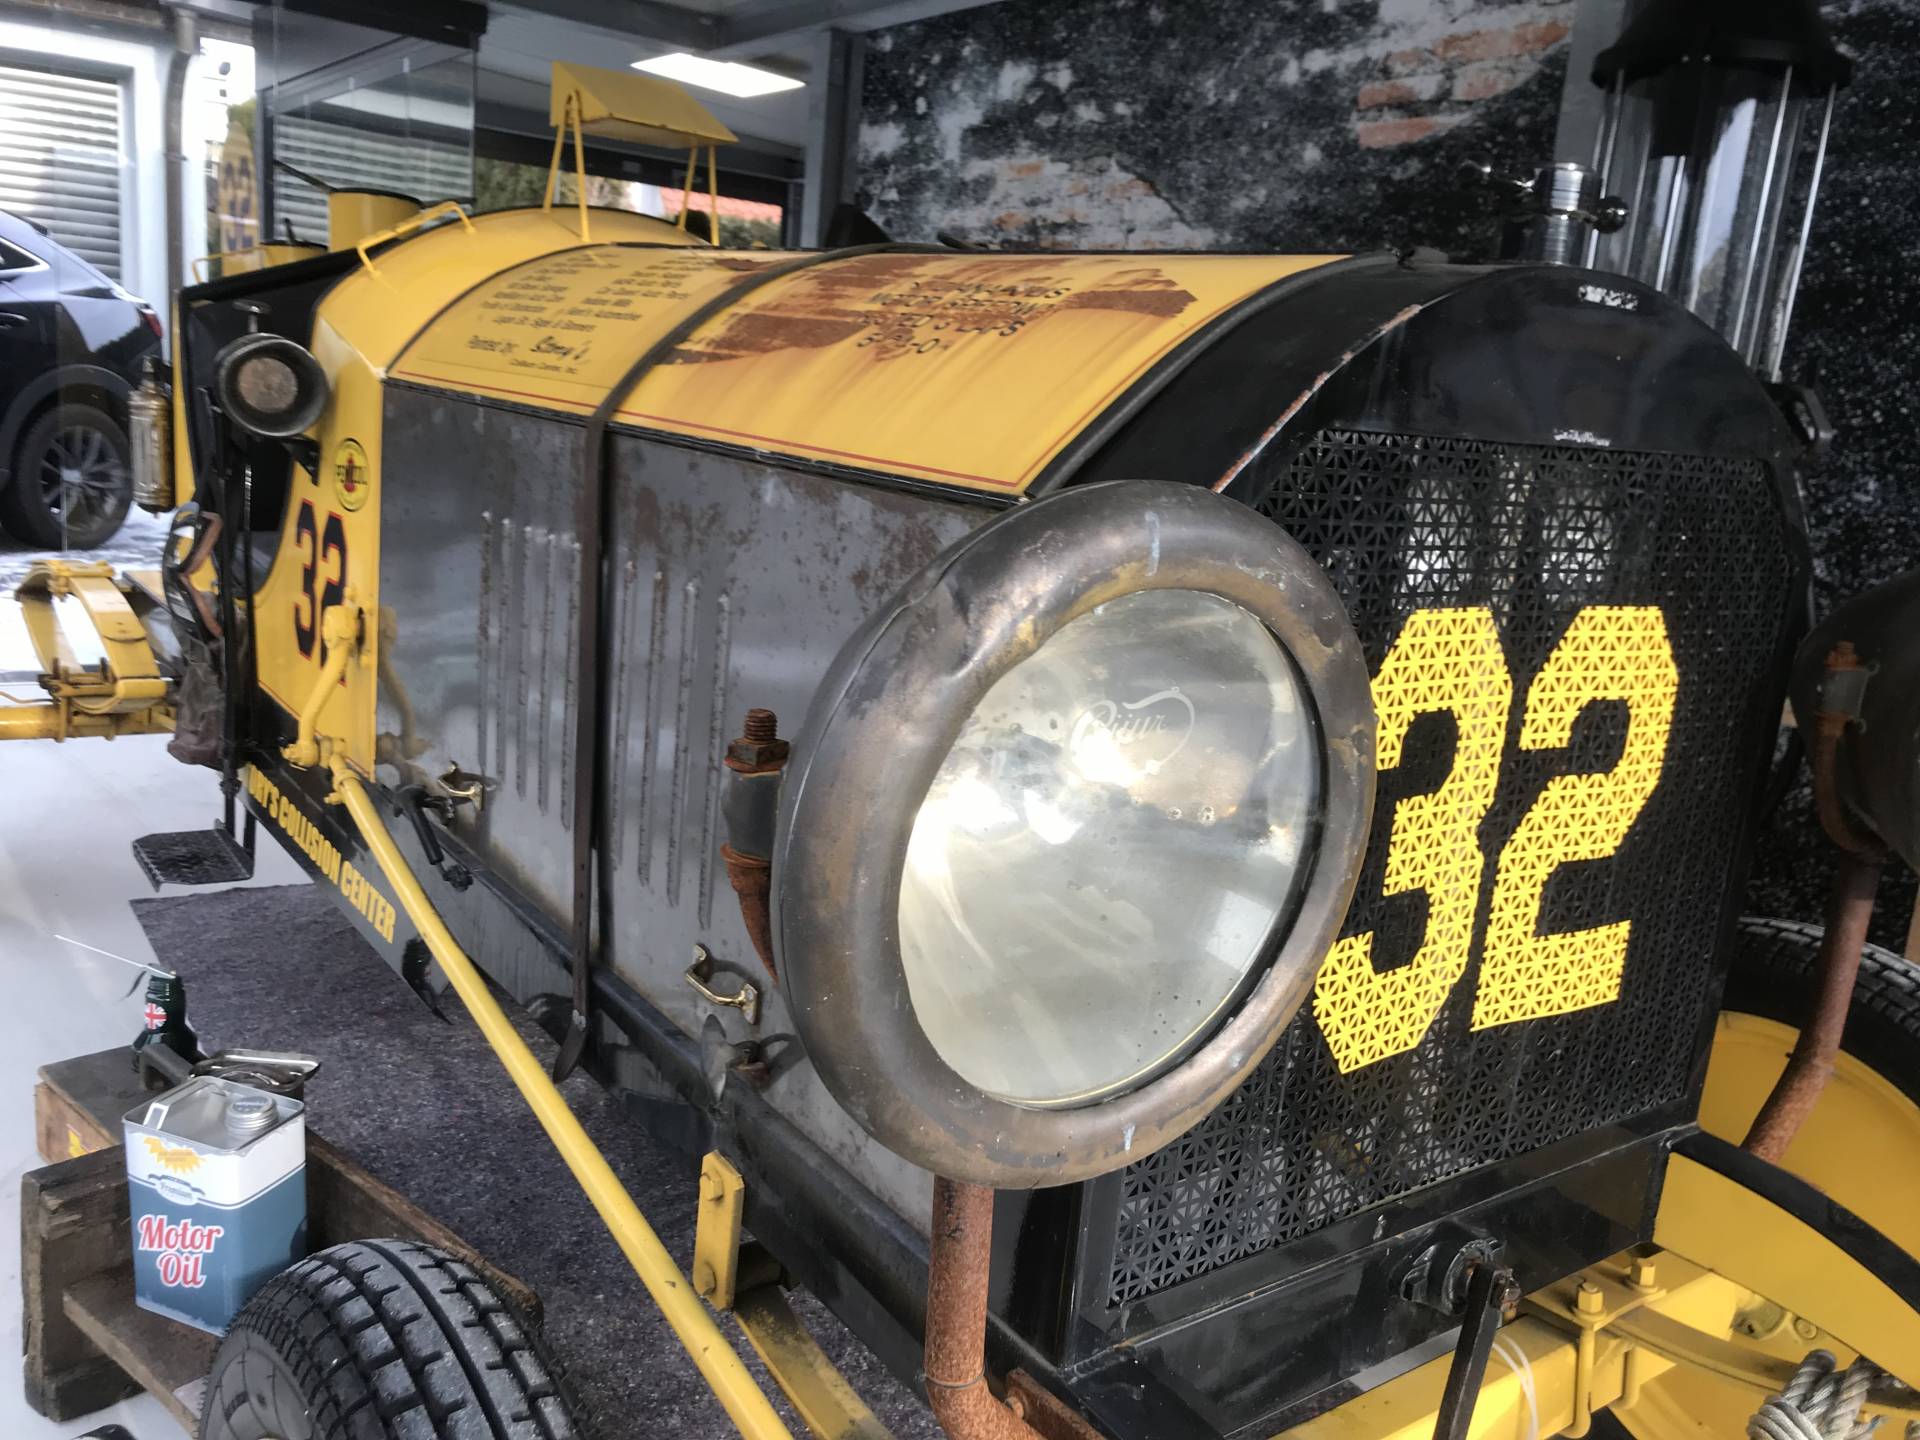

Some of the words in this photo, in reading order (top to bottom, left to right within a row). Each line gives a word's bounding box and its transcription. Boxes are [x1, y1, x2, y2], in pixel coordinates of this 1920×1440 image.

[278, 796, 342, 886] COLLISION
[340, 860, 397, 945] CENTER
[1313, 605, 1679, 1074] 32
[138, 1214, 225, 1253] Motor
[157, 1252, 208, 1289] Oil
